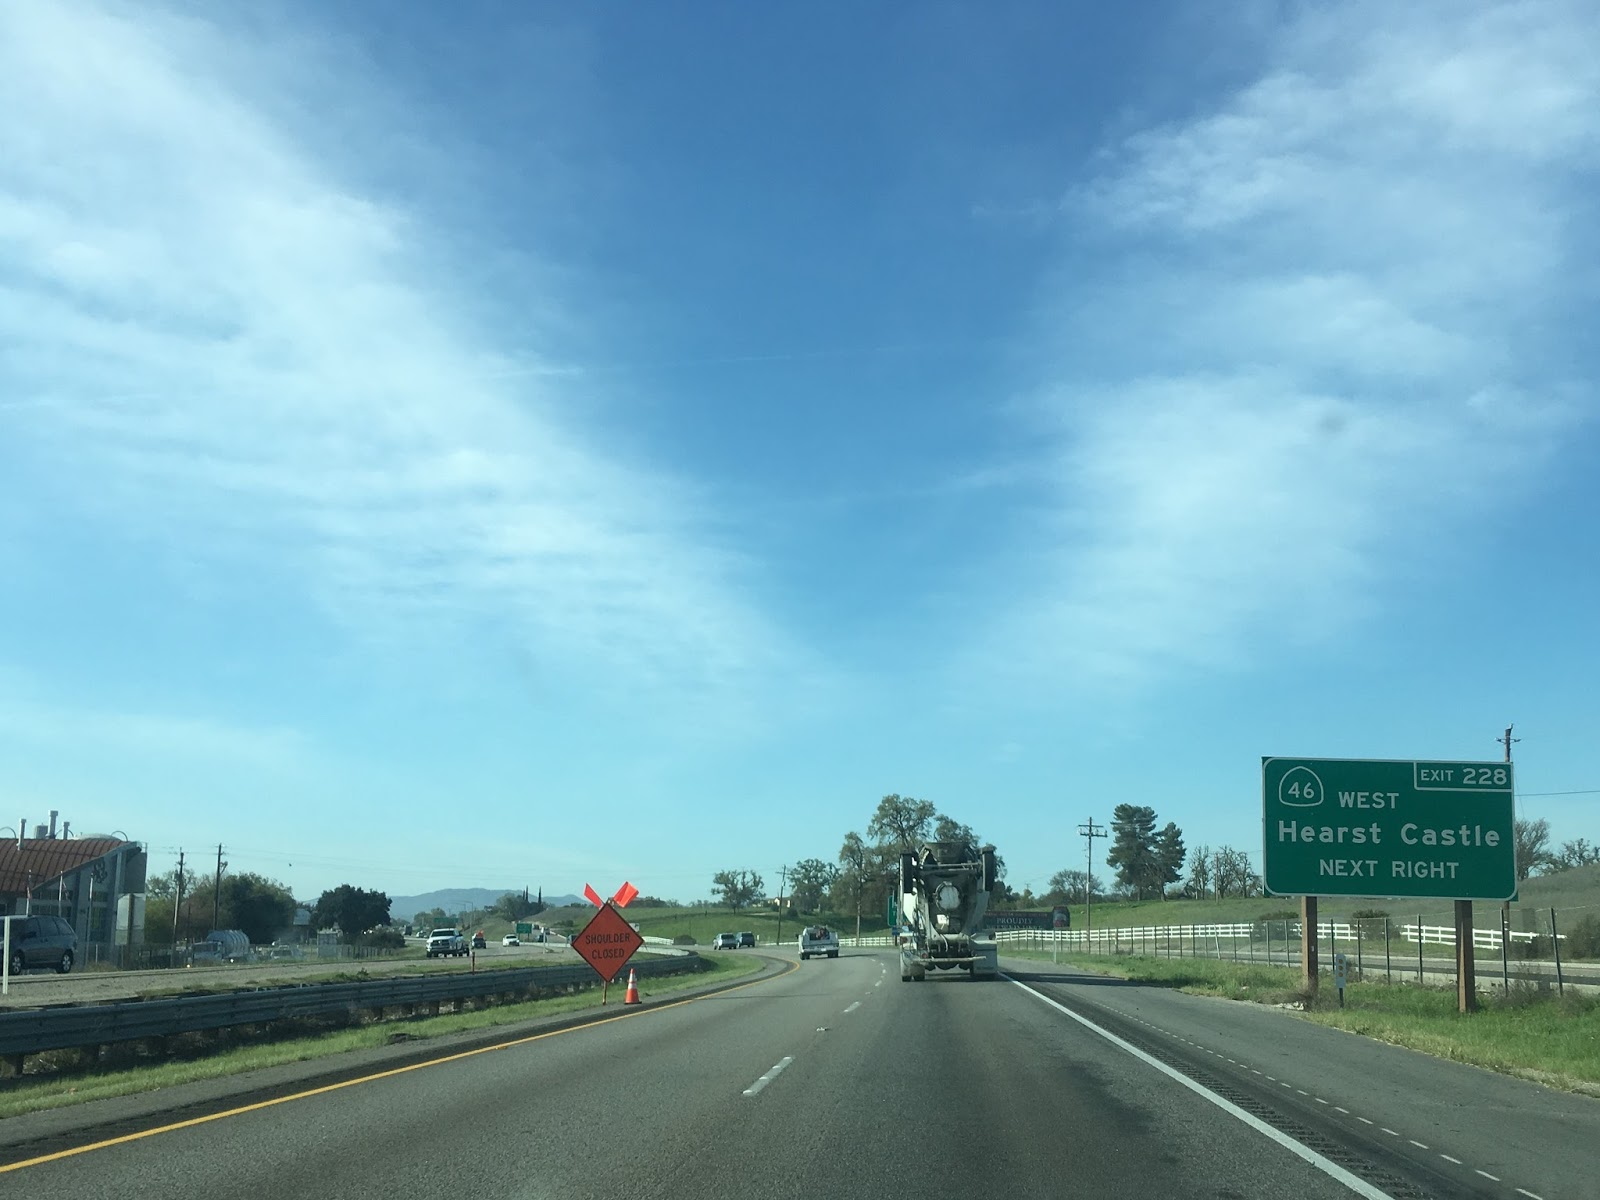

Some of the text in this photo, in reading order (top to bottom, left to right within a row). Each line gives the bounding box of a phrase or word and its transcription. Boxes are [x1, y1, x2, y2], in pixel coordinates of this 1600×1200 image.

[1420, 768, 1508, 785] EXIT 228
[1287, 781, 1315, 799] 46
[1338, 791, 1400, 809] WEST
[1278, 820, 1500, 847] Hearst Castle
[1319, 858, 1460, 879] NEXT RIGHT
[996, 917, 1034, 925] PROUDLY
[586, 933, 630, 944] SHOULDER
[592, 949, 624, 959] CLOSED
